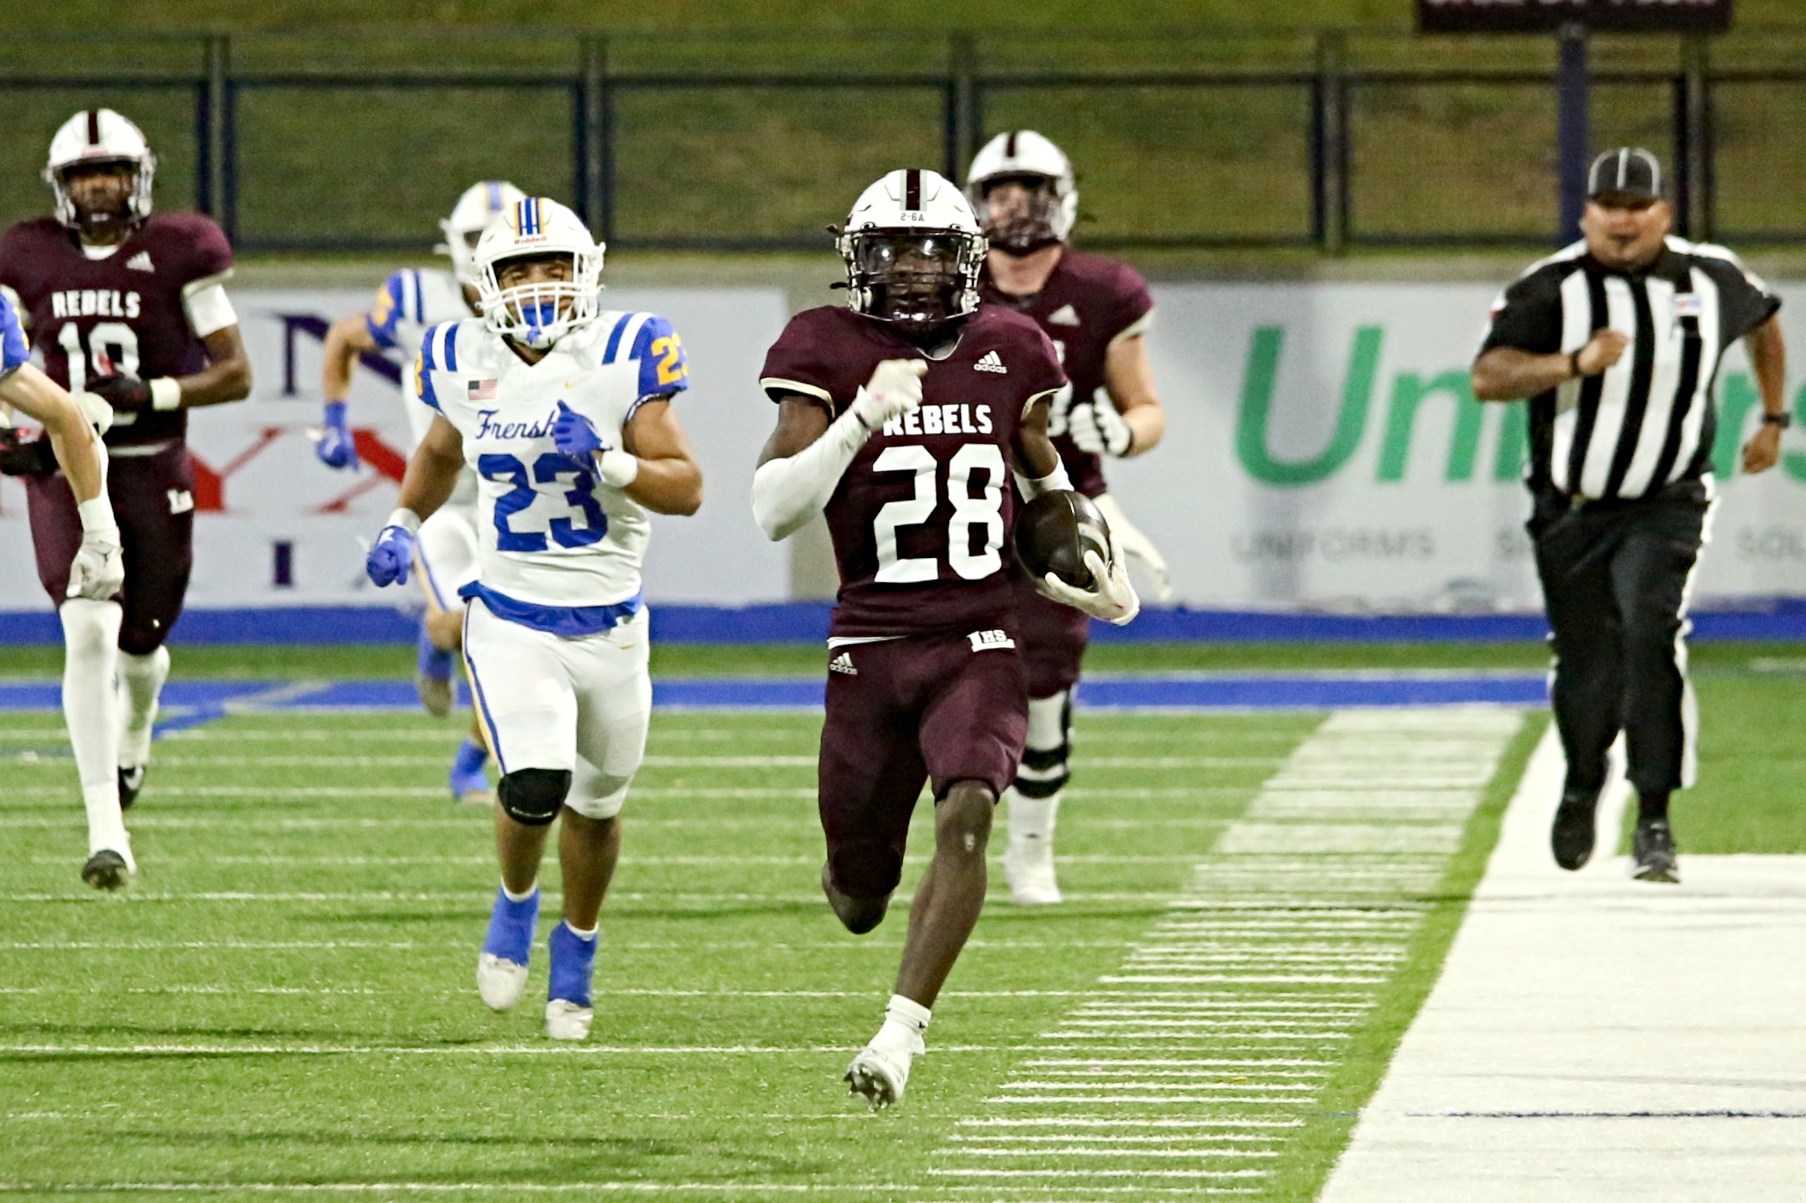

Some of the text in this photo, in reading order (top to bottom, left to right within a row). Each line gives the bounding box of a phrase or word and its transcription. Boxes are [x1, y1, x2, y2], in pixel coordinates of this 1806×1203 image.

[900, 212, 925, 222] 2-6A
[52, 289, 141, 318] REBELS
[973, 363, 1008, 374] adidas
[883, 403, 993, 436] REBELS
[478, 452, 608, 552] 23
[872, 443, 1005, 583] 28
